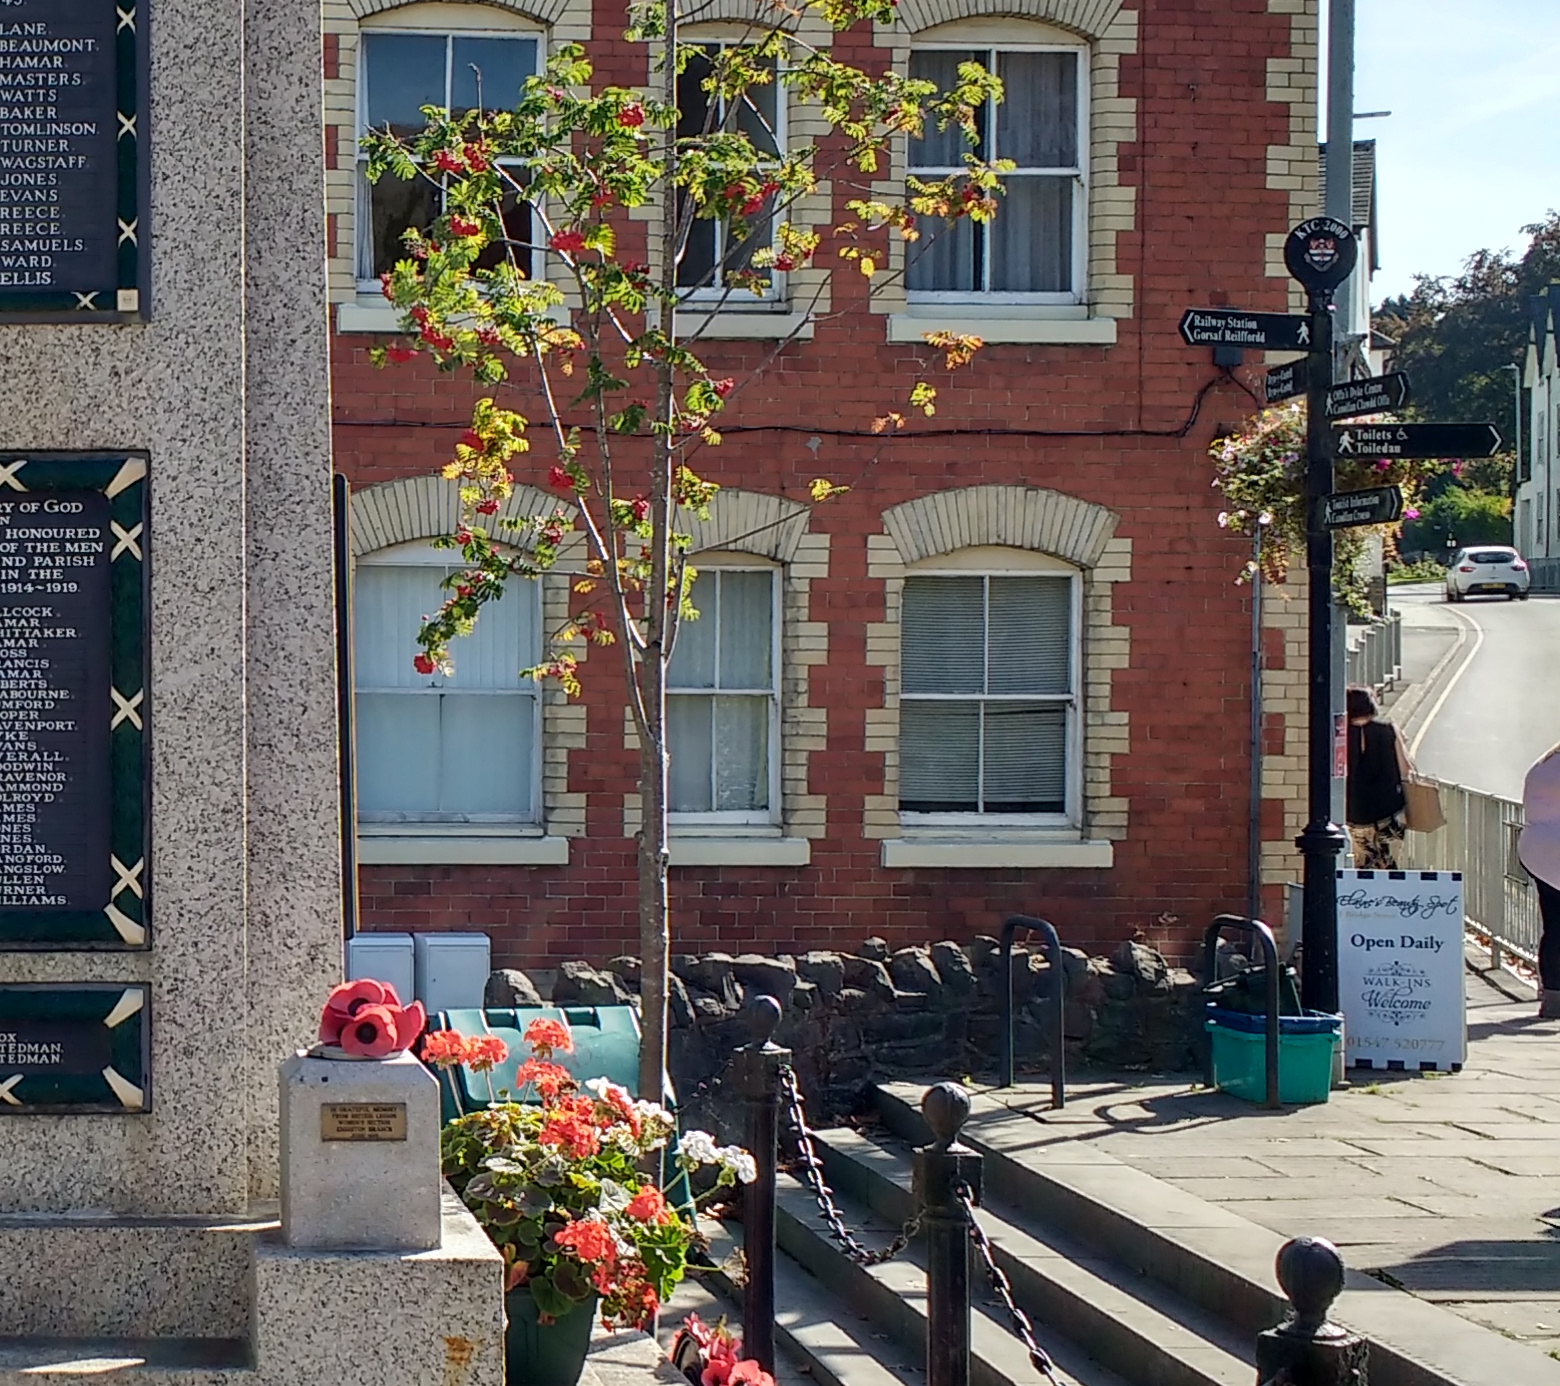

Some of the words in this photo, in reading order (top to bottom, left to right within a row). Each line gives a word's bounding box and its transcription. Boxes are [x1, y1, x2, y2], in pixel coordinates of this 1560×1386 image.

[0, 89, 57, 103] WATTS
[0, 106, 57, 120] BAKER
[0, 189, 58, 202] EVANS
[1294, 219, 1320, 240] KTC
[1323, 220, 1349, 239] 2000
[1194, 316, 1226, 329] Railway
[1228, 317, 1257, 329] Station
[1193, 329, 1222, 341] Gorsaf
[1225, 331, 1265, 343] Reilffordd
[1355, 430, 1392, 440] Toilets
[1355, 443, 1401, 453] Toiledau
[20, 502, 41, 514] OF
[43, 499, 84, 514] GOD
[5, 528, 101, 540] HONOURED
[23, 542, 61, 554] THE
[64, 542, 104, 553] MEN
[33, 555, 96, 567] PARISH
[0, 568, 20, 580] IN
[27, 568, 64, 580] THE
[1383, 895, 1424, 918] Beauty
[1421, 895, 1459, 919] Spot
[1350, 934, 1395, 951] Open
[1400, 935, 1444, 953] Daily
[1363, 977, 1431, 988] WALK-INS
[1361, 986, 1432, 1010] Welcome
